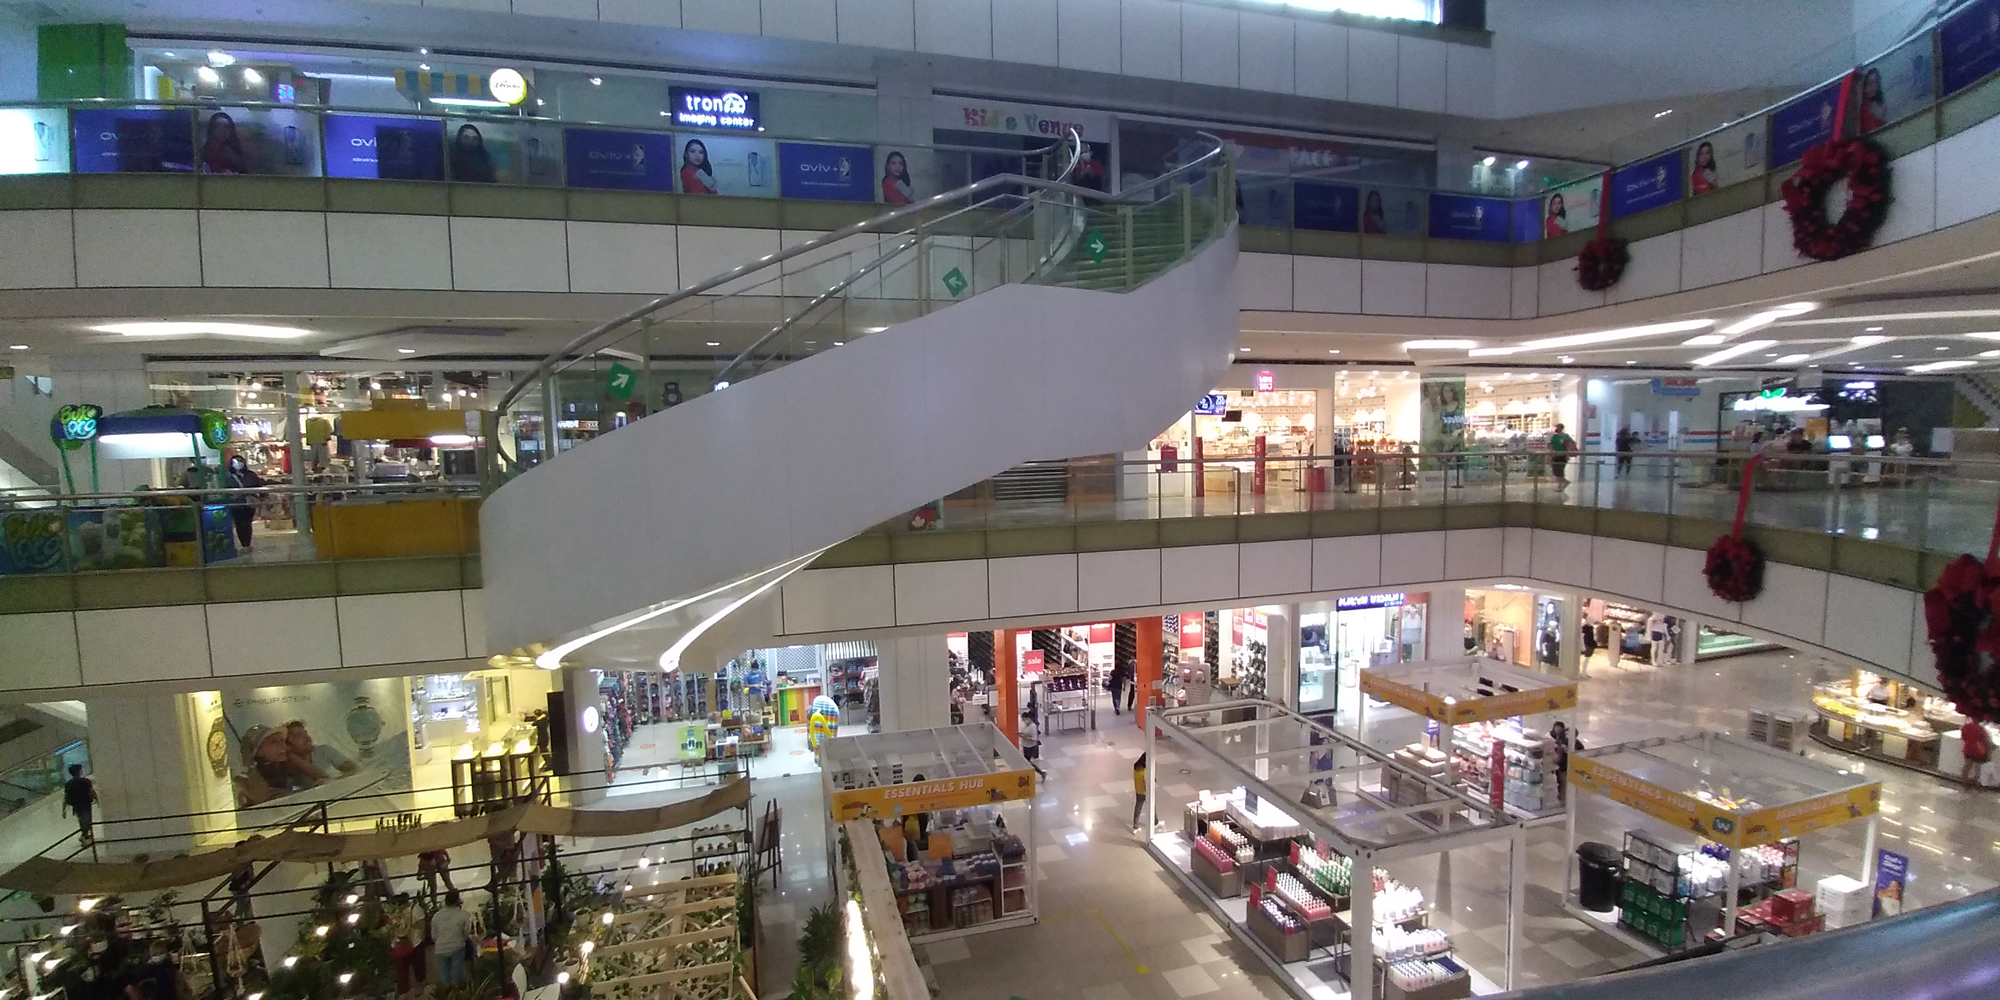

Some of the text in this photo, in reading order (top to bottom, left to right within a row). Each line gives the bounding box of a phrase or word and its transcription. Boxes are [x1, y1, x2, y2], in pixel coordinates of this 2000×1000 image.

[1027, 657, 1042, 665] sale
[246, 695, 311, 705] PHILIP STEIN
[884, 783, 955, 800] ESSENTIALS
[959, 778, 984, 790] HUB
